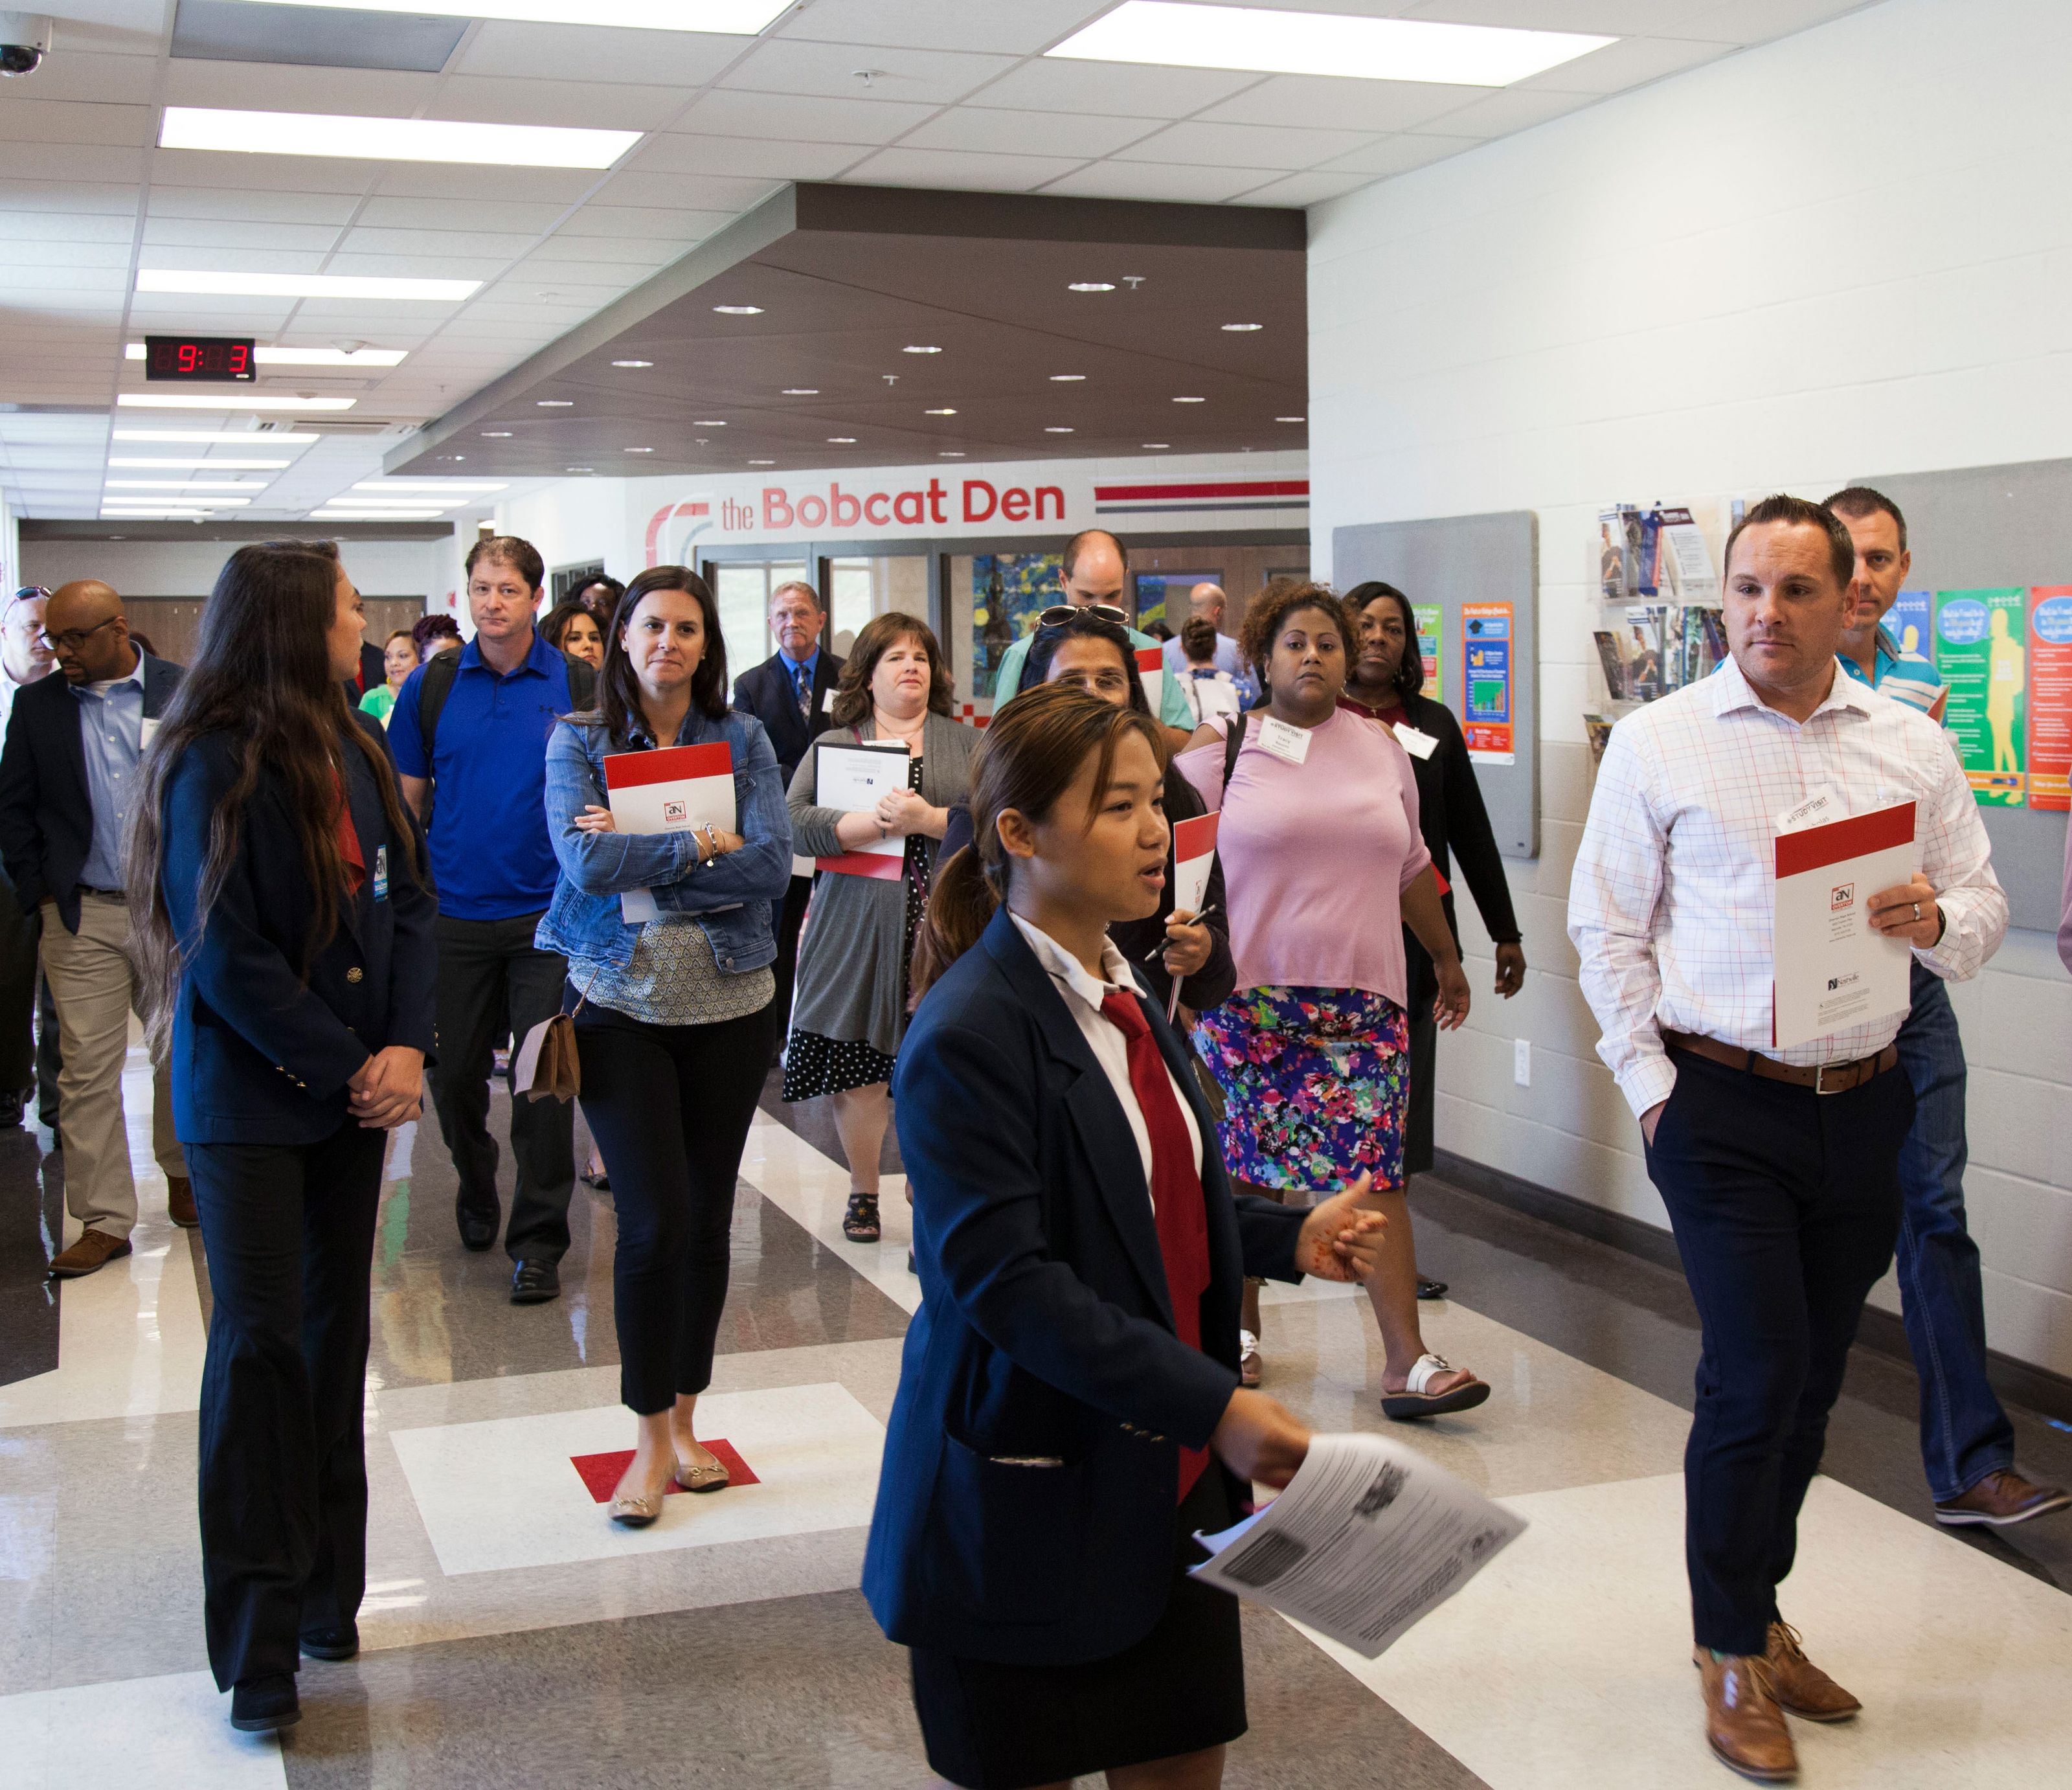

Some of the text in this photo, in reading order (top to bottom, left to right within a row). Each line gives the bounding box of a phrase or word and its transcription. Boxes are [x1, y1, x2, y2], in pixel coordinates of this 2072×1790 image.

[721, 478, 1065, 530] the Bobcat Den
[1791, 797, 1827, 821] STUDY VISIT
[1832, 900, 1852, 909] OVERTON
